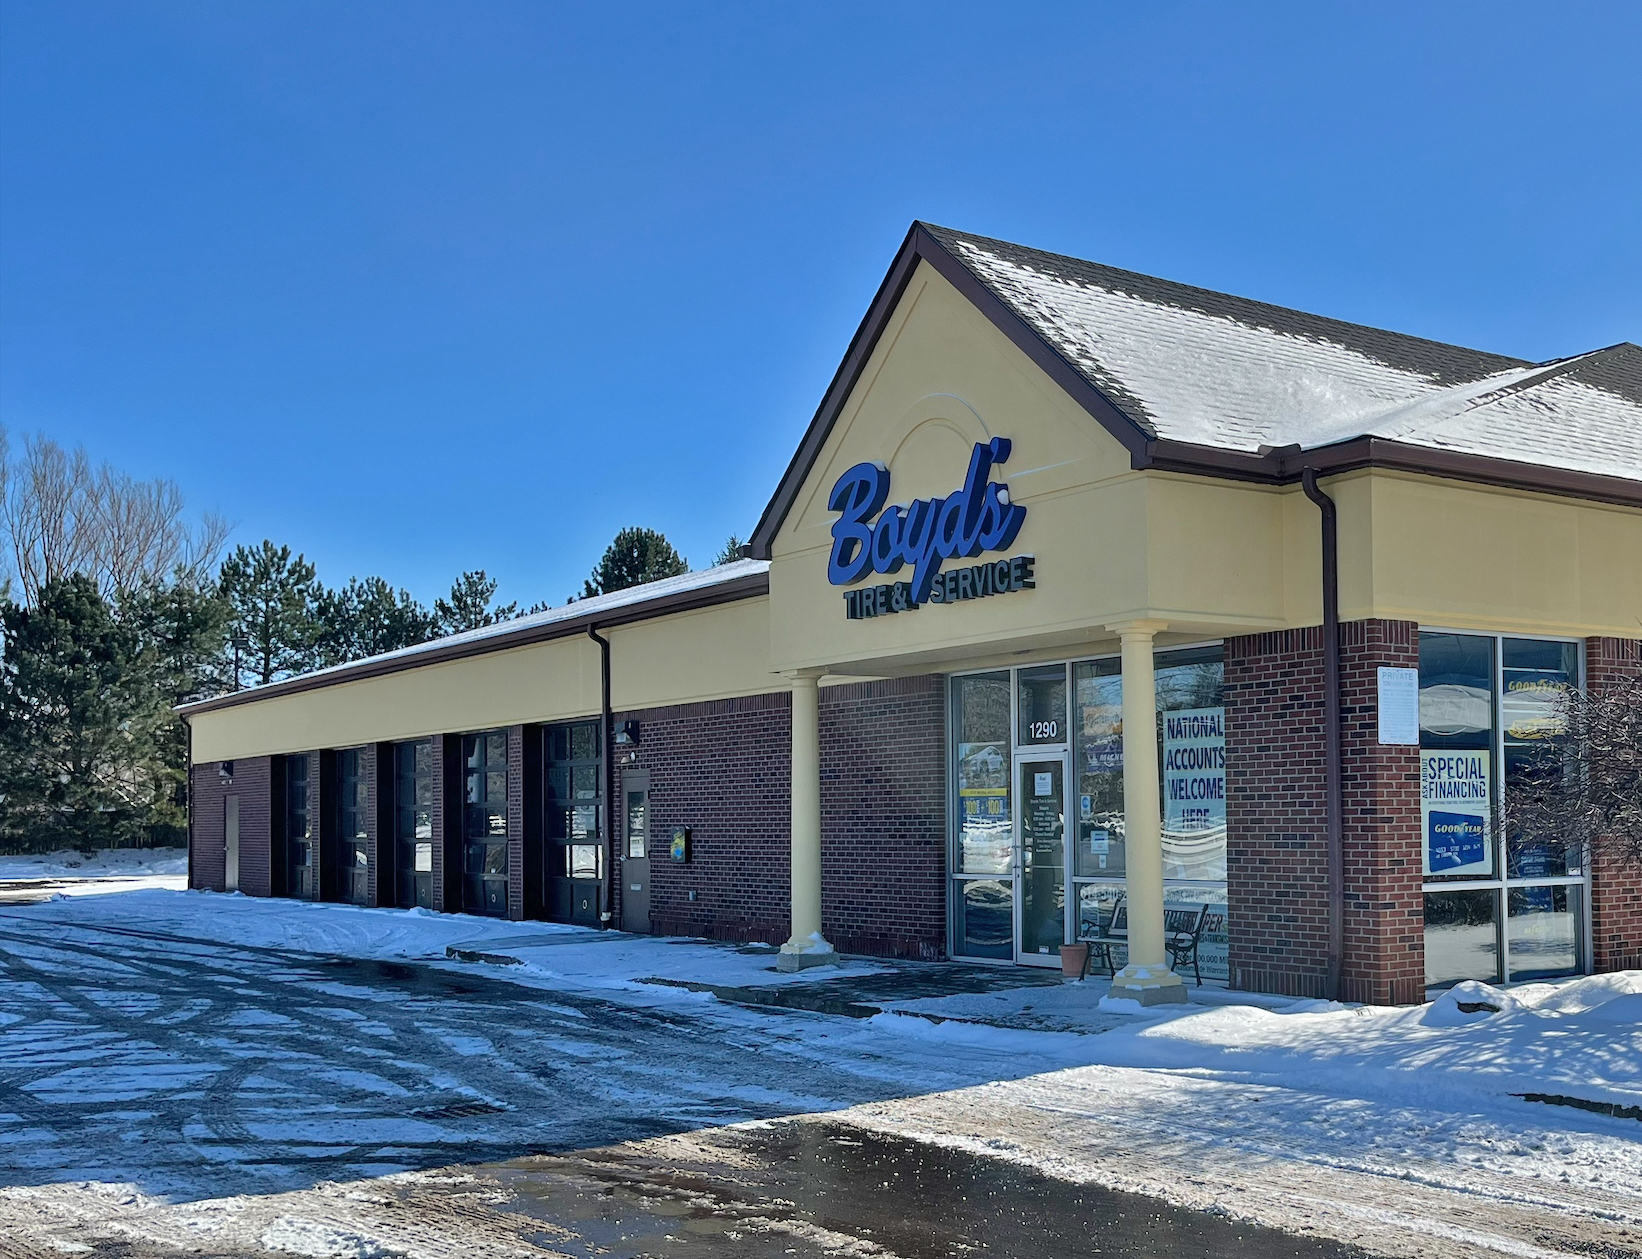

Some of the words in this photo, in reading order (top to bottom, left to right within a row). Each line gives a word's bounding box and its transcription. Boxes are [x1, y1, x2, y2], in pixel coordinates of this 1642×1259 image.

[827, 436, 1027, 604] Boyd's
[843, 585, 890, 619] TIRE
[890, 581, 908, 612] &
[930, 555, 1036, 604] SERVICE
[1382, 671, 1414, 681] PRIVATE
[1029, 720, 1058, 739] 1290
[1167, 714, 1224, 740] NATIONAL
[1100, 753, 1124, 761] MICHE
[1166, 746, 1226, 771] ACCOUNTS
[1428, 756, 1486, 780] SPECIAL
[1167, 777, 1224, 800] WELCOME
[1421, 784, 1429, 799] ASK
[1428, 780, 1486, 799] FINANCING
[1434, 821, 1483, 834] GOODYEAR
[1197, 954, 1218, 963] 00,000
